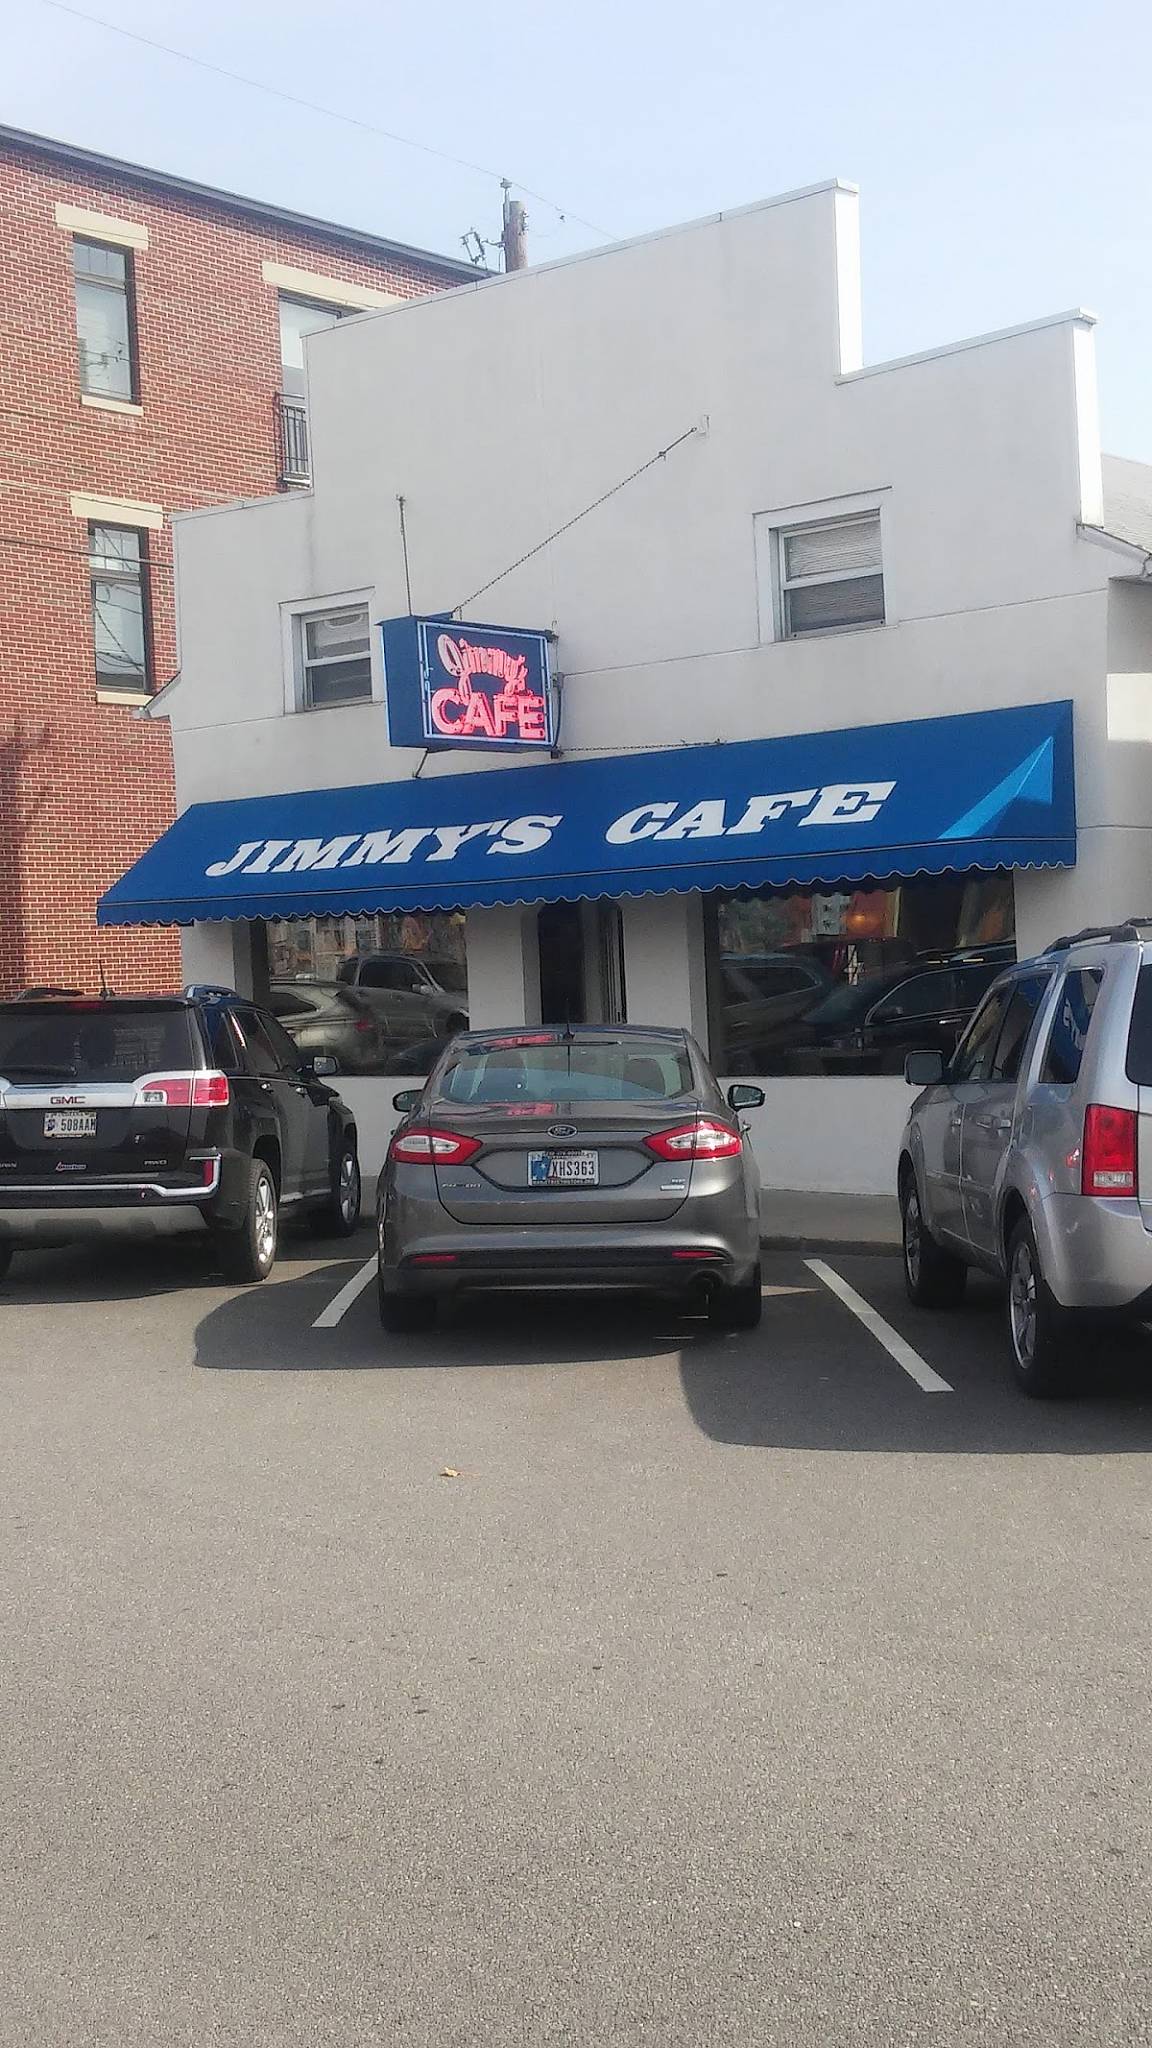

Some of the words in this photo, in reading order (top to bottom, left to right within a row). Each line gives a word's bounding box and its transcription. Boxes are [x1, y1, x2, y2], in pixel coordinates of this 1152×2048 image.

[431, 687, 545, 739] CAFE
[204, 814, 564, 878] JIMMY'S
[605, 780, 897, 845] CAFE
[50, 1095, 87, 1105] GMC
[552, 1160, 595, 1178] XHS363
